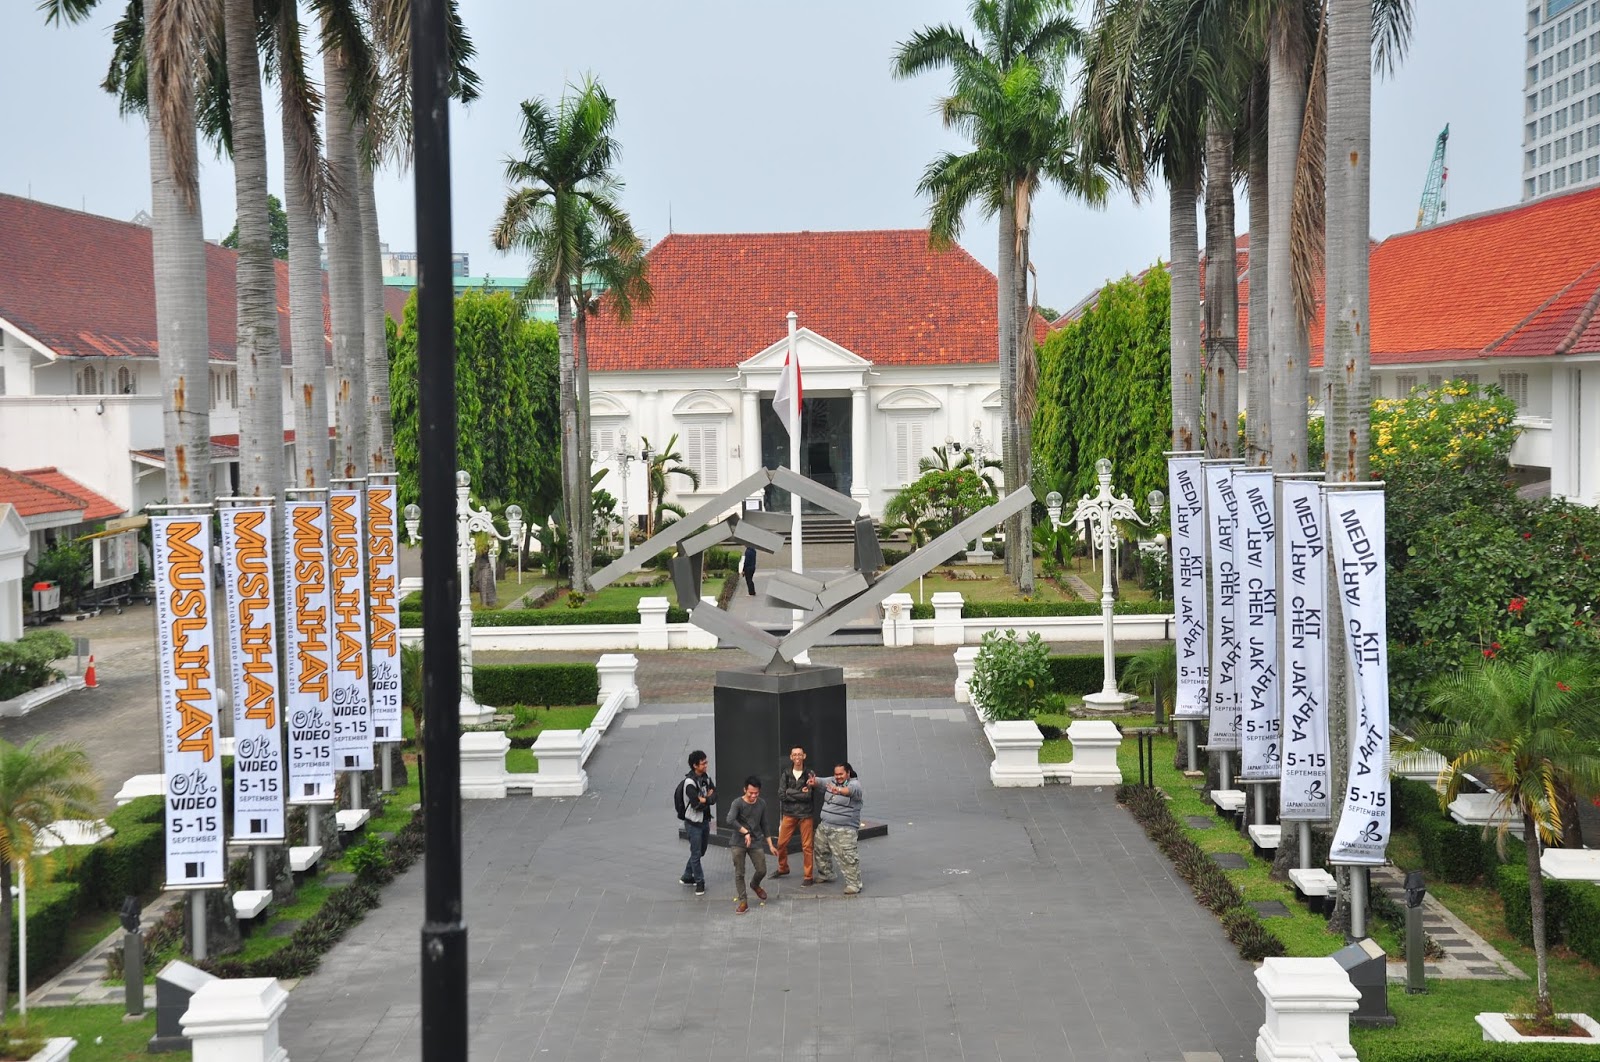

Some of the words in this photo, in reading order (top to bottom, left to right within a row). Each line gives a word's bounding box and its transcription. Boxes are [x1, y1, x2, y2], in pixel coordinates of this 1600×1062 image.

[1177, 470, 1202, 517] MEDIA
[1246, 487, 1275, 543] MEDIA
[1293, 496, 1324, 558] MEDIA
[224, 531, 232, 566] JAKARTA
[1340, 508, 1378, 576] MEDIA
[156, 544, 164, 583] JAKARTA
[368, 489, 396, 657] MUSLIHAT
[1191, 556, 1203, 579] KIT
[227, 570, 236, 633] INTERNATIONAL
[292, 507, 329, 702] MUSLIHAT
[330, 496, 363, 680] MUSLIHAT
[1264, 588, 1276, 616] KIT
[159, 586, 169, 656] INTERNATIONAL
[233, 511, 275, 729] MUSLIHAT
[1305, 608, 1321, 640] KIT
[166, 521, 215, 763] MUSLIHAT
[1363, 632, 1380, 666] KIT
[163, 660, 171, 686] VIDEO
[372, 681, 398, 690] IDEO
[164, 689, 173, 729] FESTIVAL
[333, 705, 367, 717] VIDEO
[1215, 692, 1242, 704] 5-1
[166, 734, 174, 754] 2013
[292, 729, 330, 741] VIDEO
[238, 760, 278, 772] VIDEO
[293, 761, 330, 769] SEPTEMBER
[1286, 769, 1326, 777] SEPTEMBER
[170, 796, 217, 811] VIDEO
[1348, 805, 1386, 817] SEPTEMBER
[172, 835, 217, 845] SEPTEMBER
